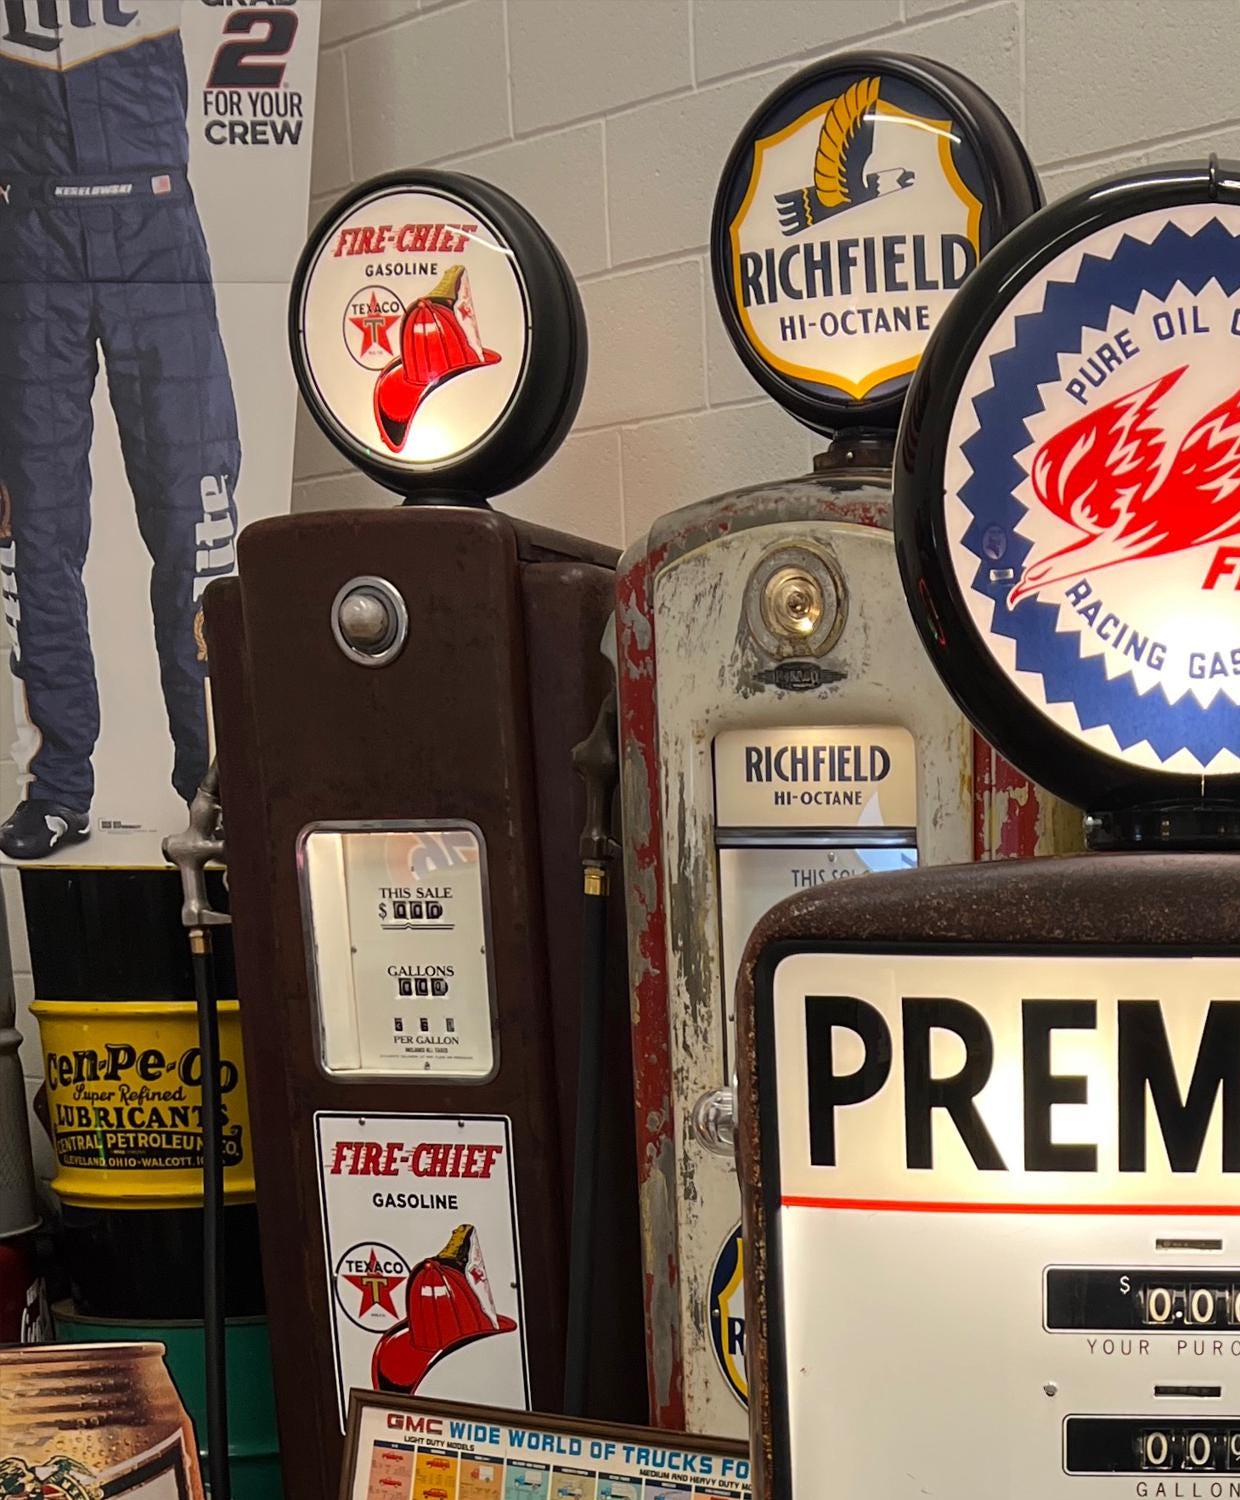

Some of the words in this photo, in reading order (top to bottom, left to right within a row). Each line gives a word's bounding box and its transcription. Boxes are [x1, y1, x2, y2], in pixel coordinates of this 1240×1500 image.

[207, 8, 299, 89] 2
[203, 90, 243, 116] FOR
[248, 91, 303, 117] YOUR
[204, 119, 302, 145] CREW
[333, 223, 478, 257] FIRE-CHIEF
[365, 262, 438, 277] GASOLINE
[740, 233, 977, 307] RICHFIELD
[352, 301, 400, 315] TEXACO
[779, 305, 930, 342] HI-OCTANE
[1064, 329, 1140, 405] PURE
[1154, 305, 1210, 341] OIL
[1065, 578, 1168, 672] RACING
[745, 745, 891, 783] RICHFIELD
[774, 791, 863, 806] HI-OCTANE
[379, 887, 411, 899] THIS
[416, 887, 453, 899] SALE
[387, 965, 455, 977] GALLONS
[394, 1036, 413, 1045] PER
[416, 1035, 459, 1045] GALLON
[73, 1084, 115, 1105] Super
[119, 1084, 187, 1106] Refined
[57, 1134, 103, 1154] CENTRAL
[107, 1132, 204, 1150] PETROLEU
[329, 1141, 503, 1179] FIRE-CHIEF
[372, 1193, 459, 1210] GASOLINE
[346, 1260, 404, 1275] TEXACO
[1119, 1275, 1131, 1295] $
[1086, 1338, 1150, 1355] YOUR
[387, 1413, 443, 1435] GMC
[450, 1421, 500, 1444] WIDE
[508, 1429, 582, 1456] WORLD
[590, 1441, 616, 1461] OF
[622, 1445, 713, 1475] TRUCKS
[722, 1458, 750, 1480] FO
[404, 1435, 424, 1444] LIGHT
[426, 1438, 445, 1448] DUTY
[446, 1441, 475, 1452] MODELS
[639, 1468, 670, 1480] MEDIUM
[671, 1472, 688, 1482] AND
[689, 1475, 716, 1486] HEAVY
[718, 1479, 740, 1490] DUTY
